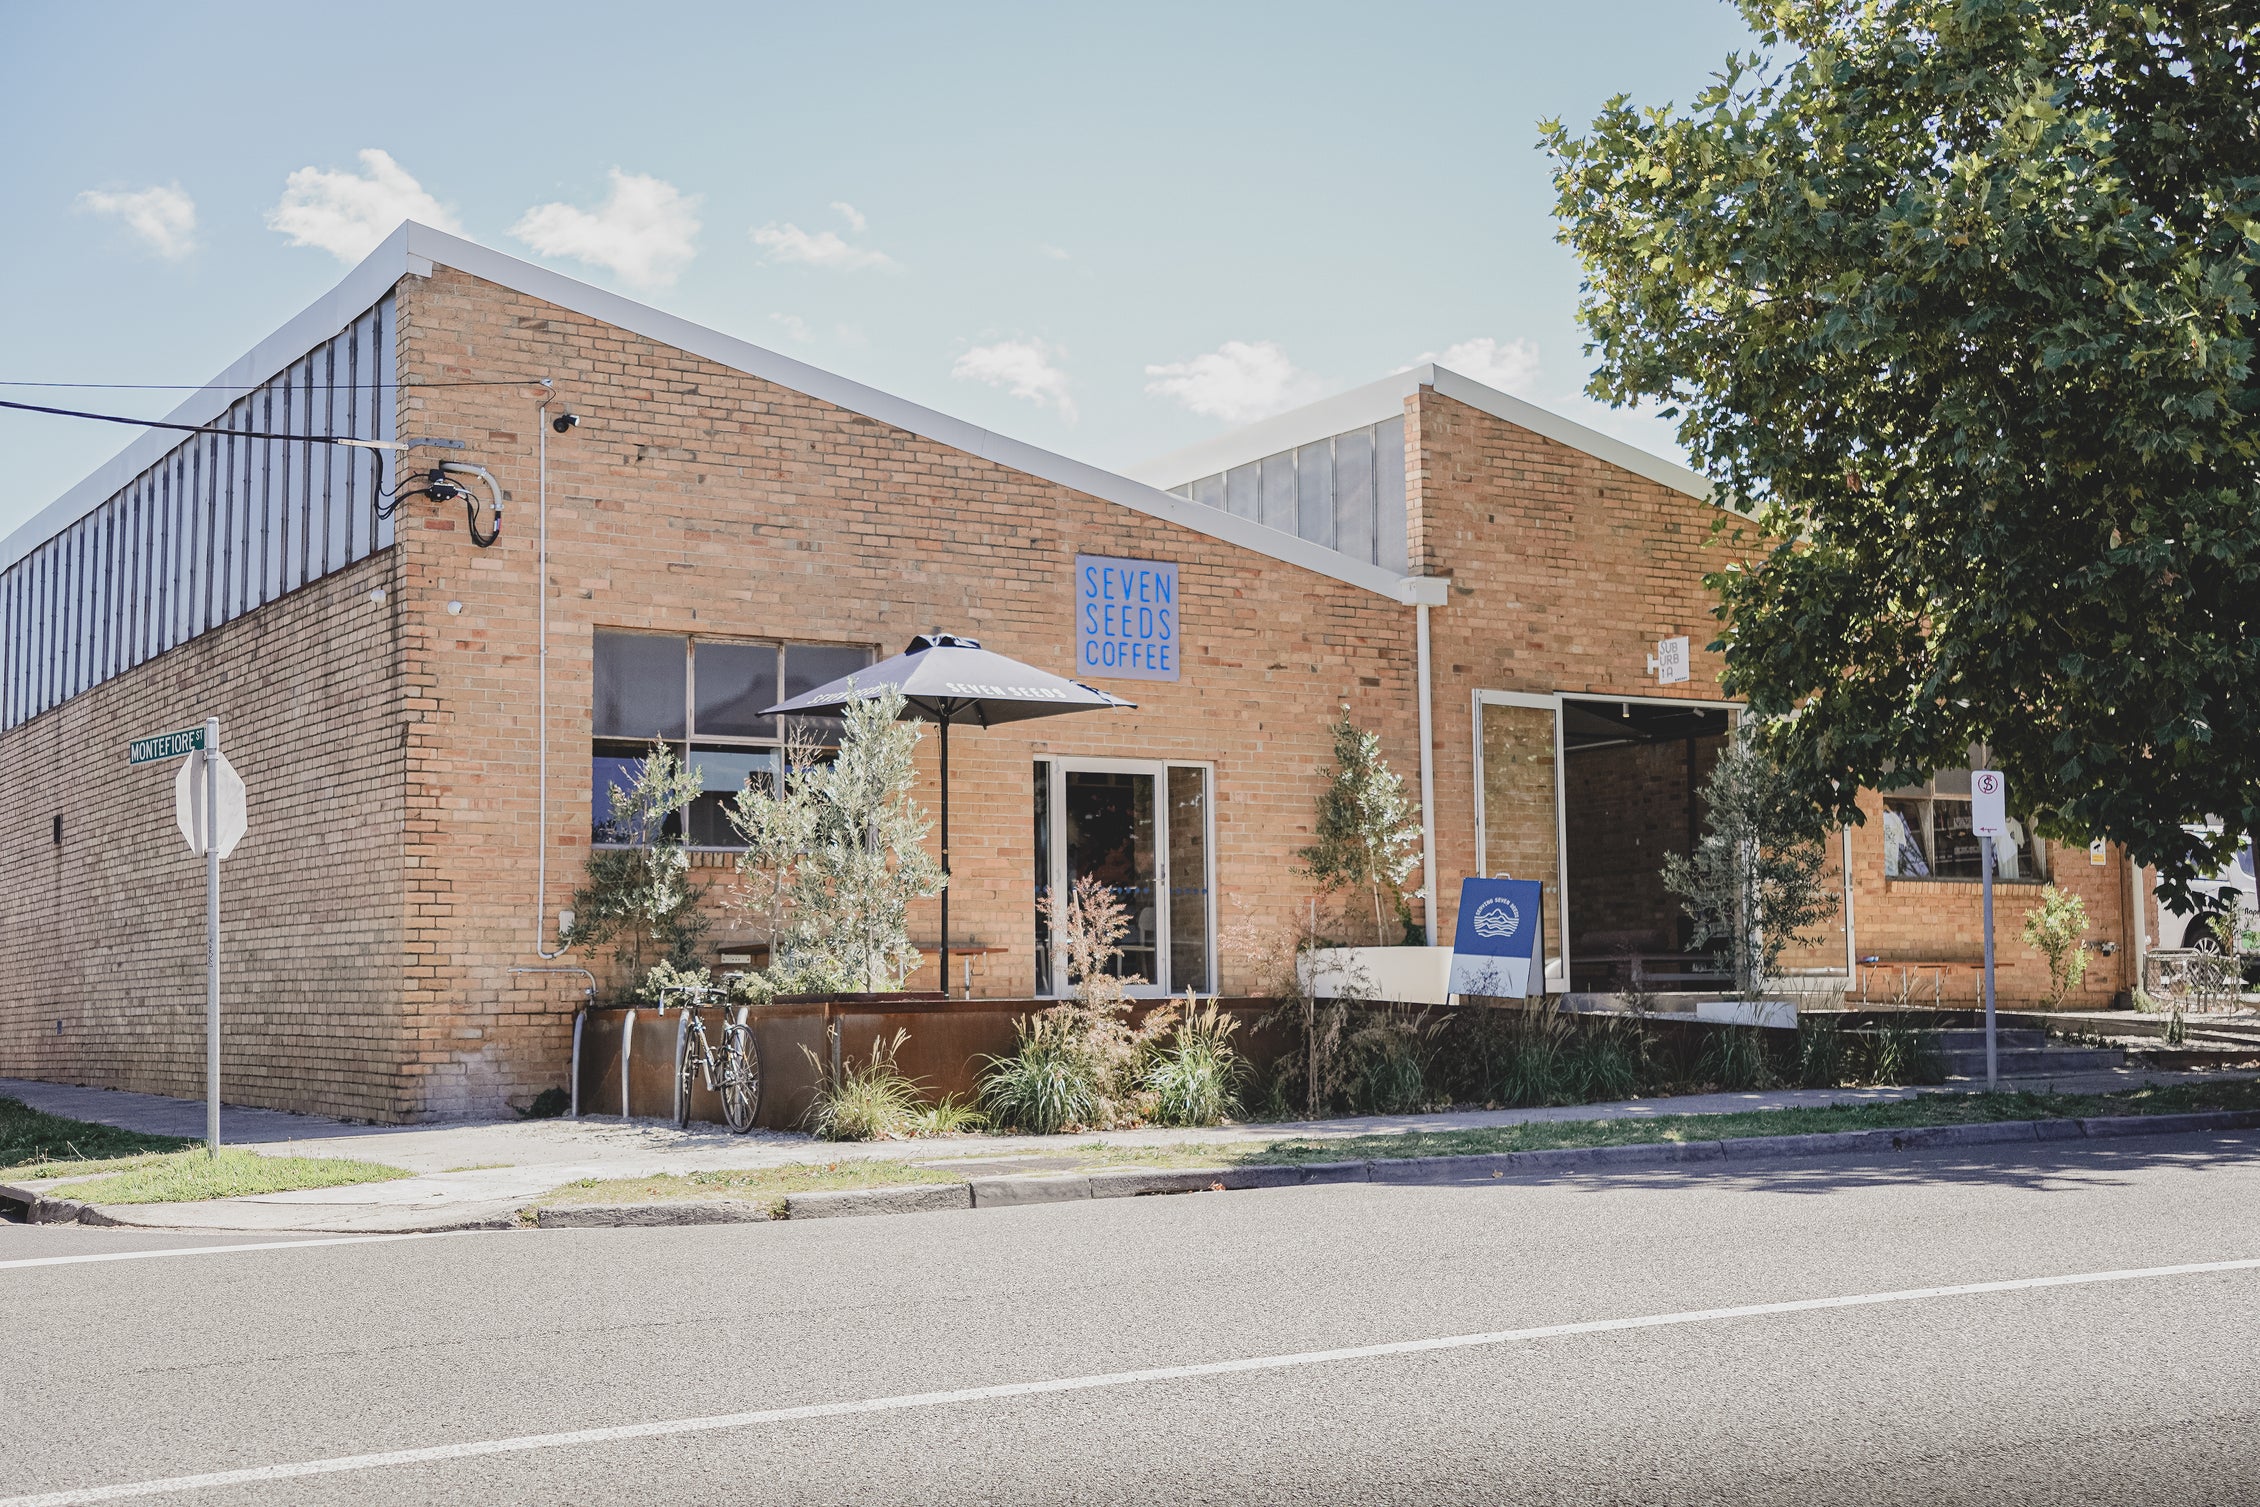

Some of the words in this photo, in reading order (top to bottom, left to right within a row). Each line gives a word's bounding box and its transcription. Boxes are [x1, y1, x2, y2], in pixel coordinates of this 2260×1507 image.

[1085, 566, 1170, 604] SEVEN
[1086, 603, 1171, 640] SEEDS
[1086, 640, 1170, 671] COFFEE
[1660, 641, 1677, 654] SUB
[1660, 653, 1679, 666] URB
[945, 682, 1006, 696] SEVEN
[1007, 686, 1067, 699] SEEDS
[131, 731, 195, 763] MONTEFIORE
[195, 729, 204, 741] ST
[1494, 897, 1510, 905] SEVEN
